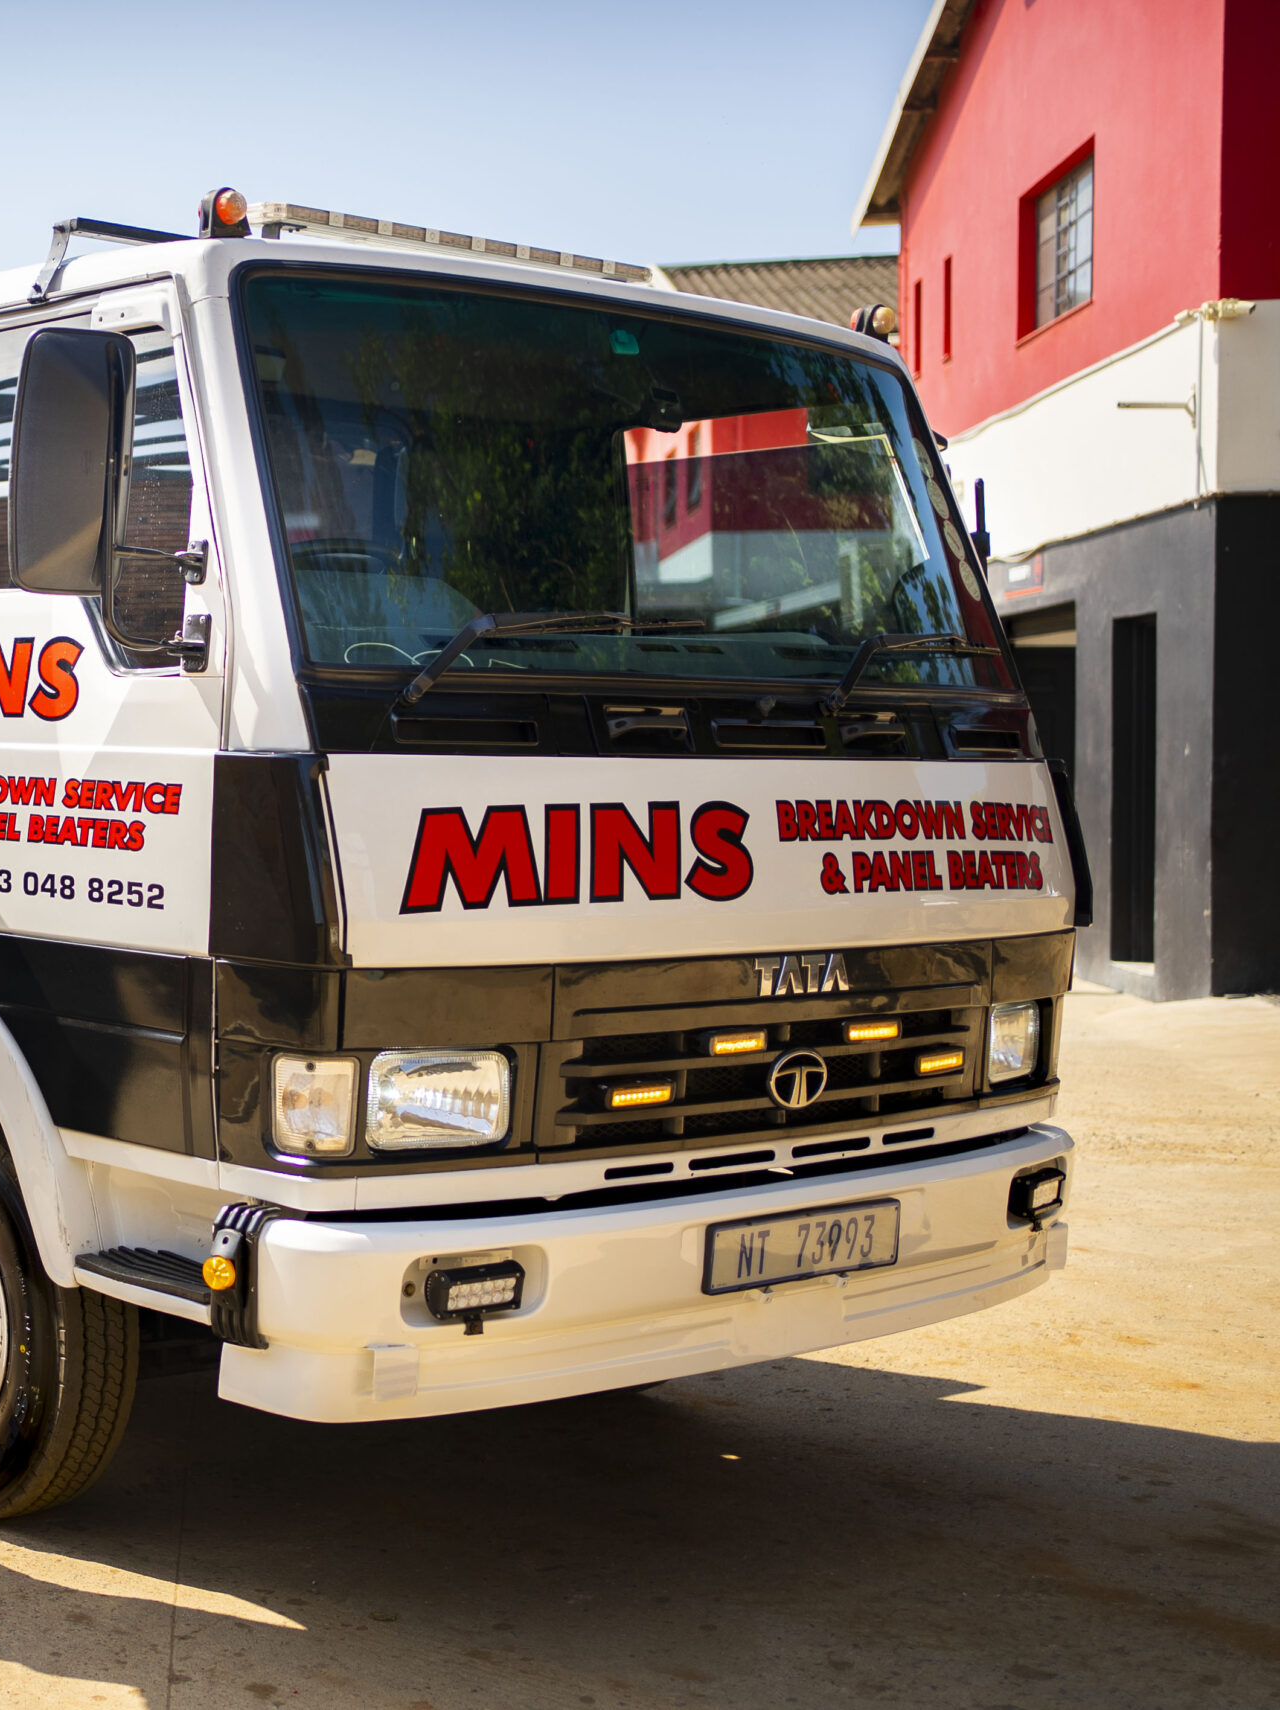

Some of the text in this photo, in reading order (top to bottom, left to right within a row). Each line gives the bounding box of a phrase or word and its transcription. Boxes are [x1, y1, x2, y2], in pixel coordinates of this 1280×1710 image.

[62, 778, 183, 814] SERVICE
[27, 814, 146, 851] BEATERS
[776, 799, 1053, 843] BREAKDOWN SERVICE
[399, 800, 754, 914] MINS
[820, 851, 1043, 895] & PANEL BEATERS
[23, 871, 75, 899] 048
[87, 877, 165, 910] 8252
[753, 953, 850, 997] TATA
[737, 1214, 875, 1278] NT 73993
